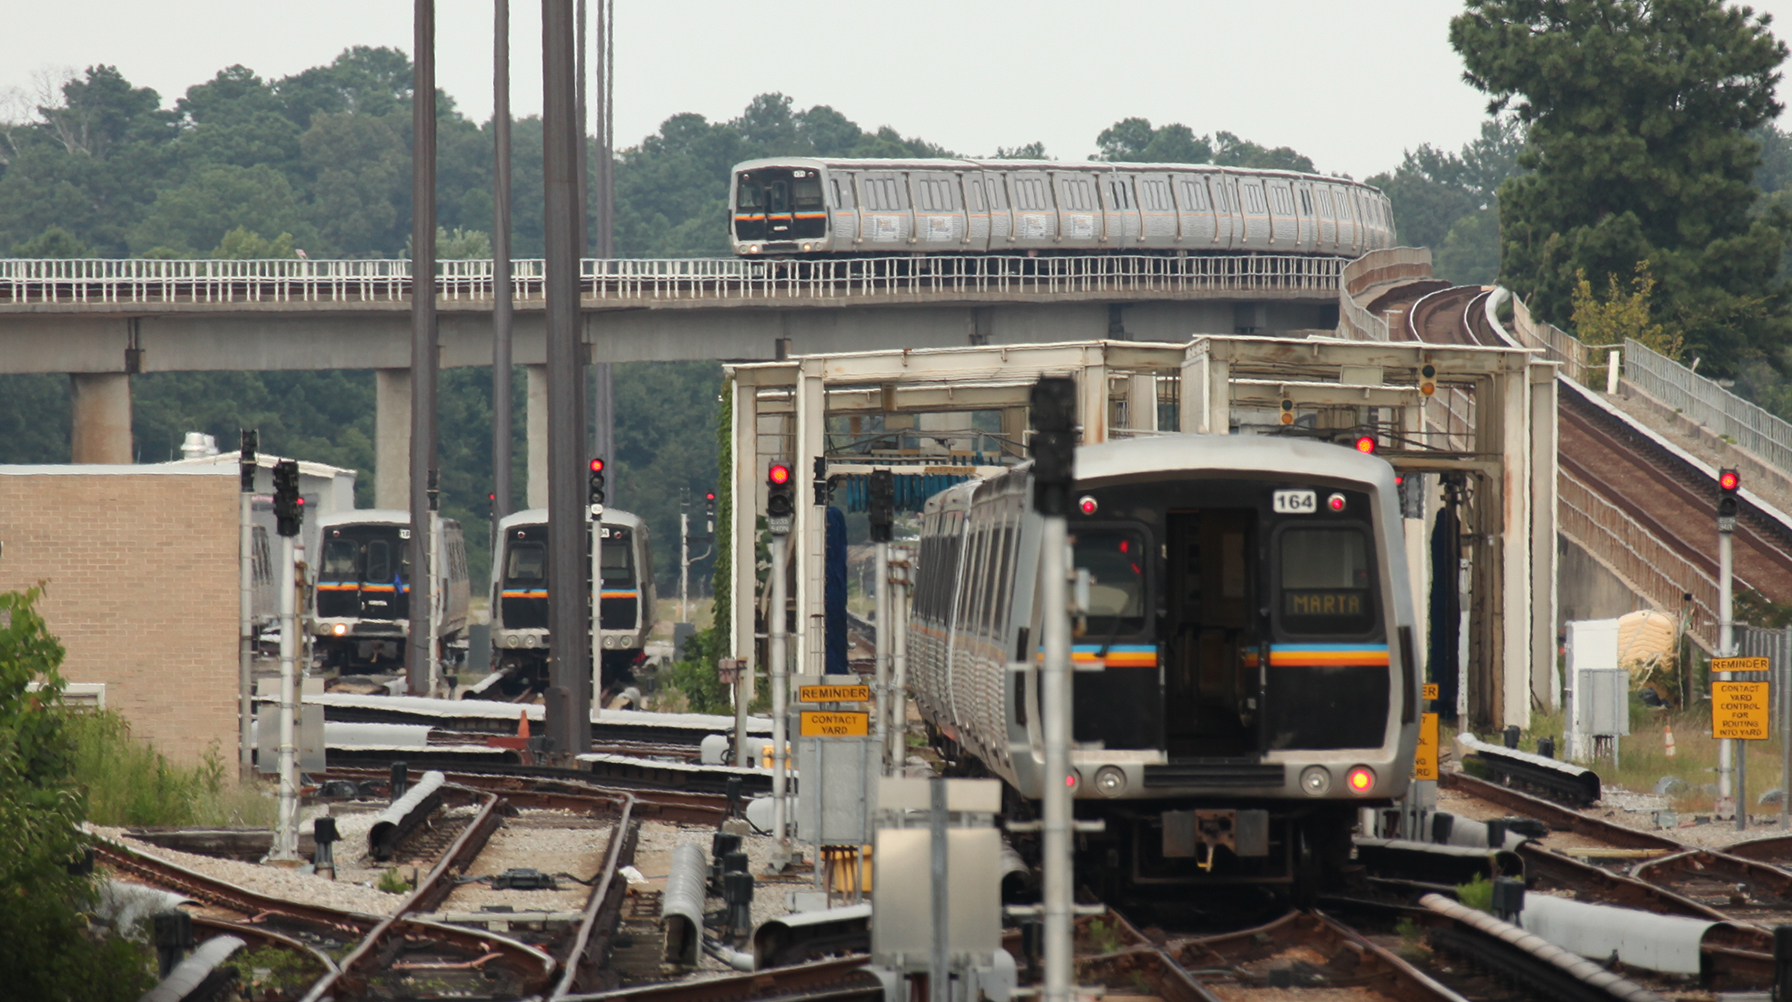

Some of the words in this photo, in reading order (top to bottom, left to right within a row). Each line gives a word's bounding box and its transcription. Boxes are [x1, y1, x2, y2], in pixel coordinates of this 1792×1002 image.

[1277, 494, 1313, 509] 164
[1293, 595, 1359, 613] MARTA
[1713, 660, 1767, 668] REMINDER
[802, 688, 867, 698] REMINDER
[812, 715, 858, 724] CONTACT
[822, 726, 848, 735] YARD
